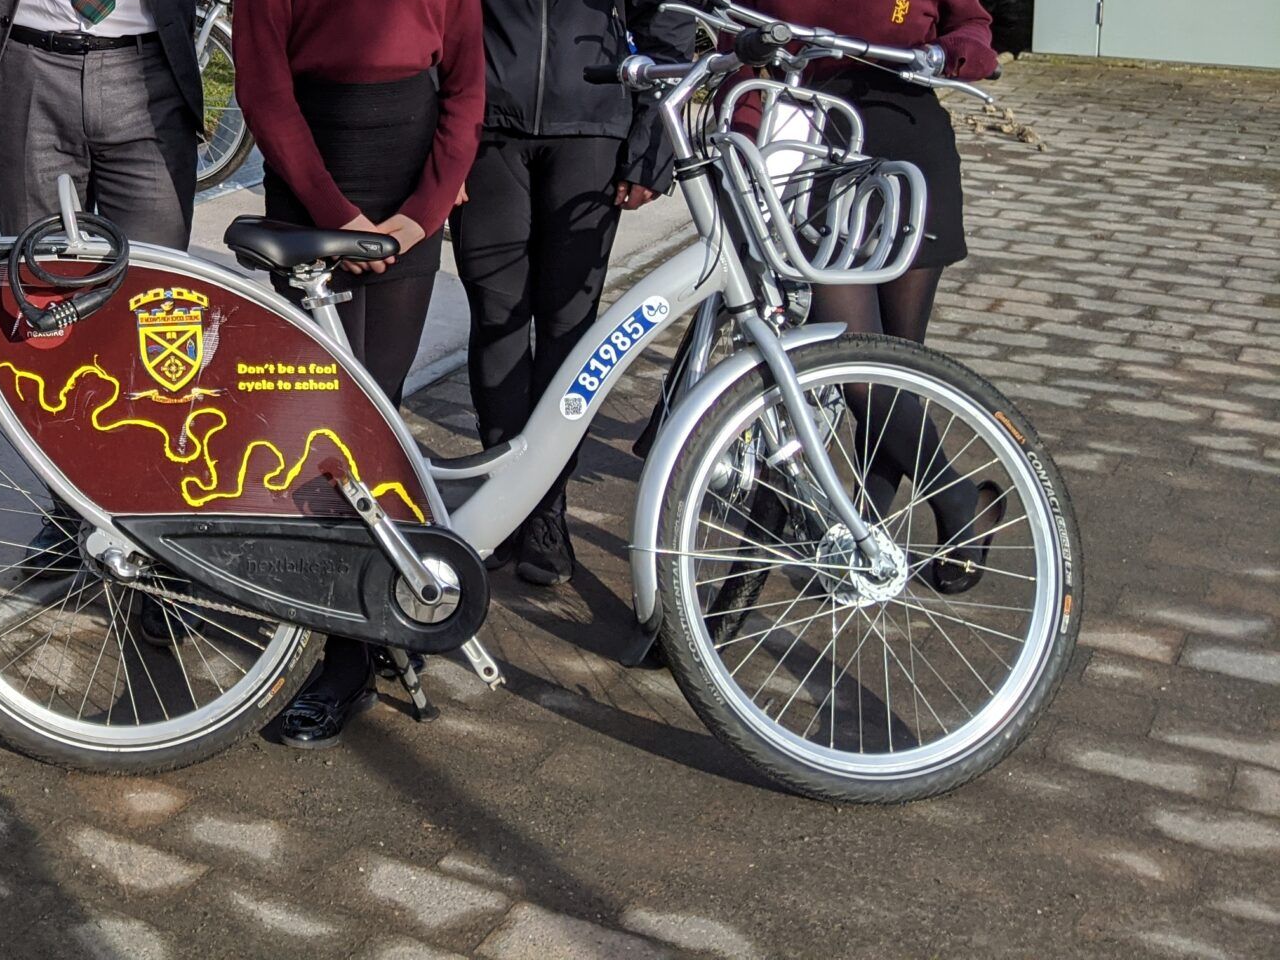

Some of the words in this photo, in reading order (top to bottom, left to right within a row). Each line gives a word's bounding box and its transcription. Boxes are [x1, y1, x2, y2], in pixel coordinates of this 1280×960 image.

[237, 363, 275, 374] Don't
[277, 363, 295, 374] be
[298, 365, 306, 374] a
[309, 363, 337, 374] fool
[578, 316, 644, 392] 81985
[238, 380, 274, 392] cycle
[277, 380, 291, 390] to
[294, 379, 339, 390] school
[1026, 451, 1061, 516] CONTACT
[1055, 515, 1071, 560] CRUISER
